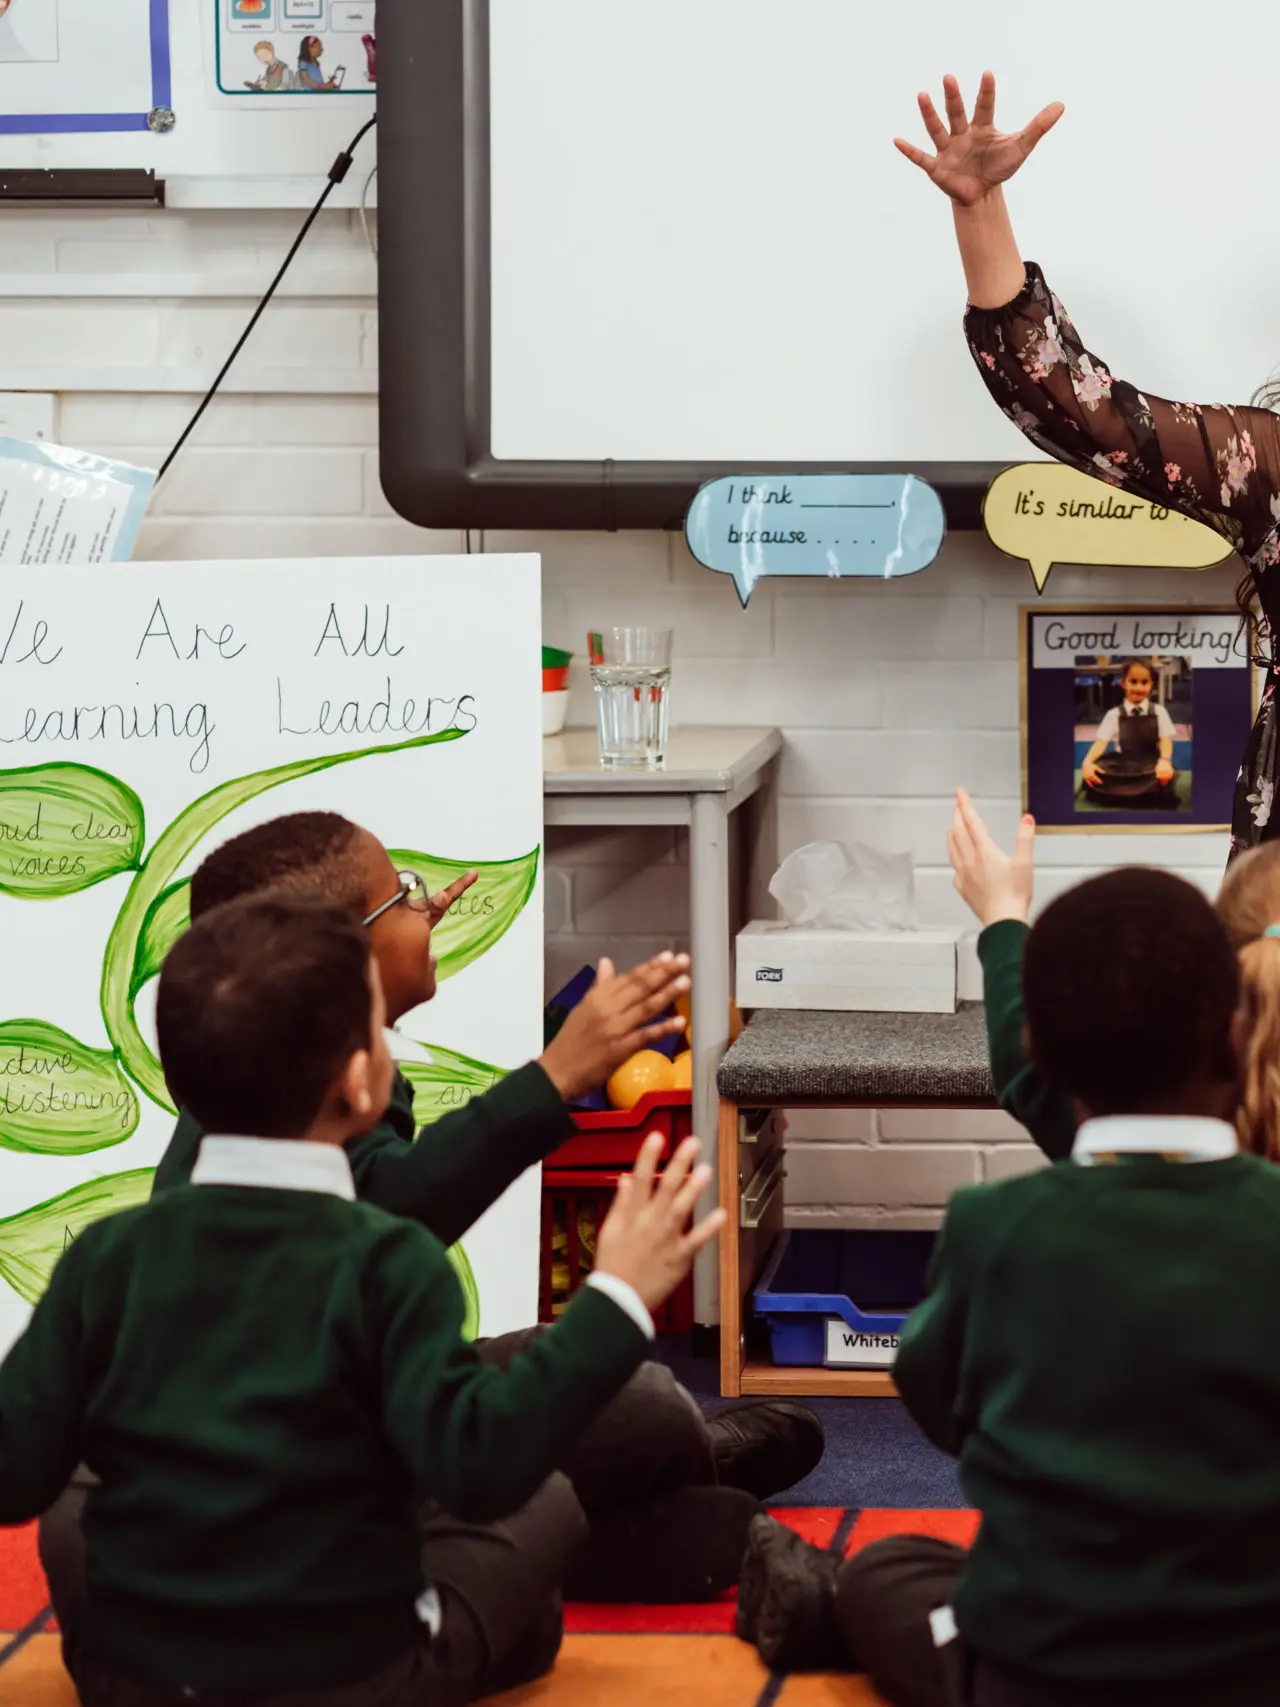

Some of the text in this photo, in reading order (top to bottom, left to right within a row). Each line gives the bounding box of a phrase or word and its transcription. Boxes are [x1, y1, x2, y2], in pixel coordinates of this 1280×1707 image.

[727, 484, 793, 504] I thnk
[1015, 490, 1169, 520] It's similar to
[137, 598, 246, 660] Are
[314, 603, 404, 657] All
[1044, 622, 1233, 664] Good looking
[0, 677, 478, 773] earning Leaders
[71, 812, 138, 841] clear
[10, 848, 86, 877] voices
[0, 1046, 80, 1075] ctive
[842, 1333, 900, 1348] Whiteb
